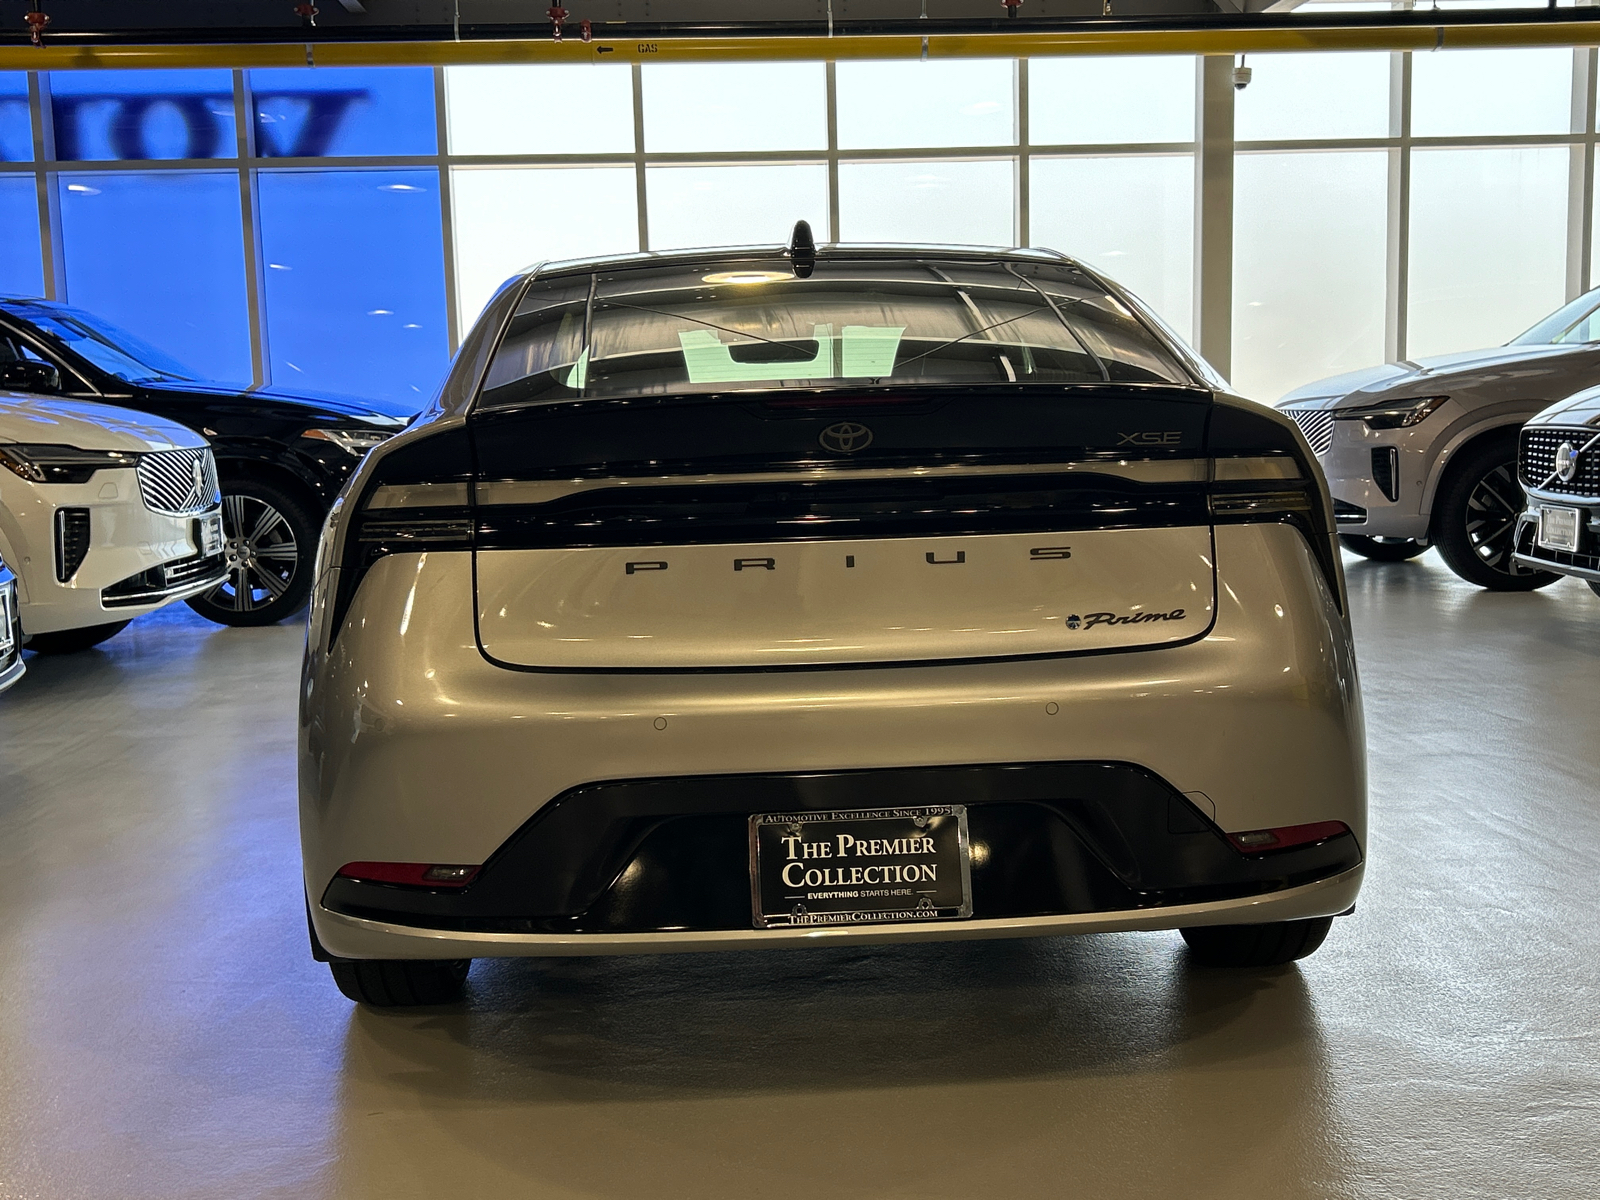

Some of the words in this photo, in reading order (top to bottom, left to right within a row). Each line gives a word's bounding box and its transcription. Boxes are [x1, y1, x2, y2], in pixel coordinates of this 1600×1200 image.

[637, 43, 658, 53] GAS
[1116, 431, 1182, 446] XSE
[625, 546, 1072, 575] PRIUS
[1083, 608, 1187, 630] Prime
[765, 812, 829, 823] AUTOMOTIVE
[831, 809, 891, 820] EXCELLENCE
[893, 808, 922, 818] SINCE
[925, 807, 951, 816] 1995
[781, 835, 832, 860] THE
[836, 834, 937, 858] PREMIER
[781, 862, 938, 888] COLLECTION
[807, 891, 859, 900] EVERYTHING
[860, 889, 889, 897] STARTS
